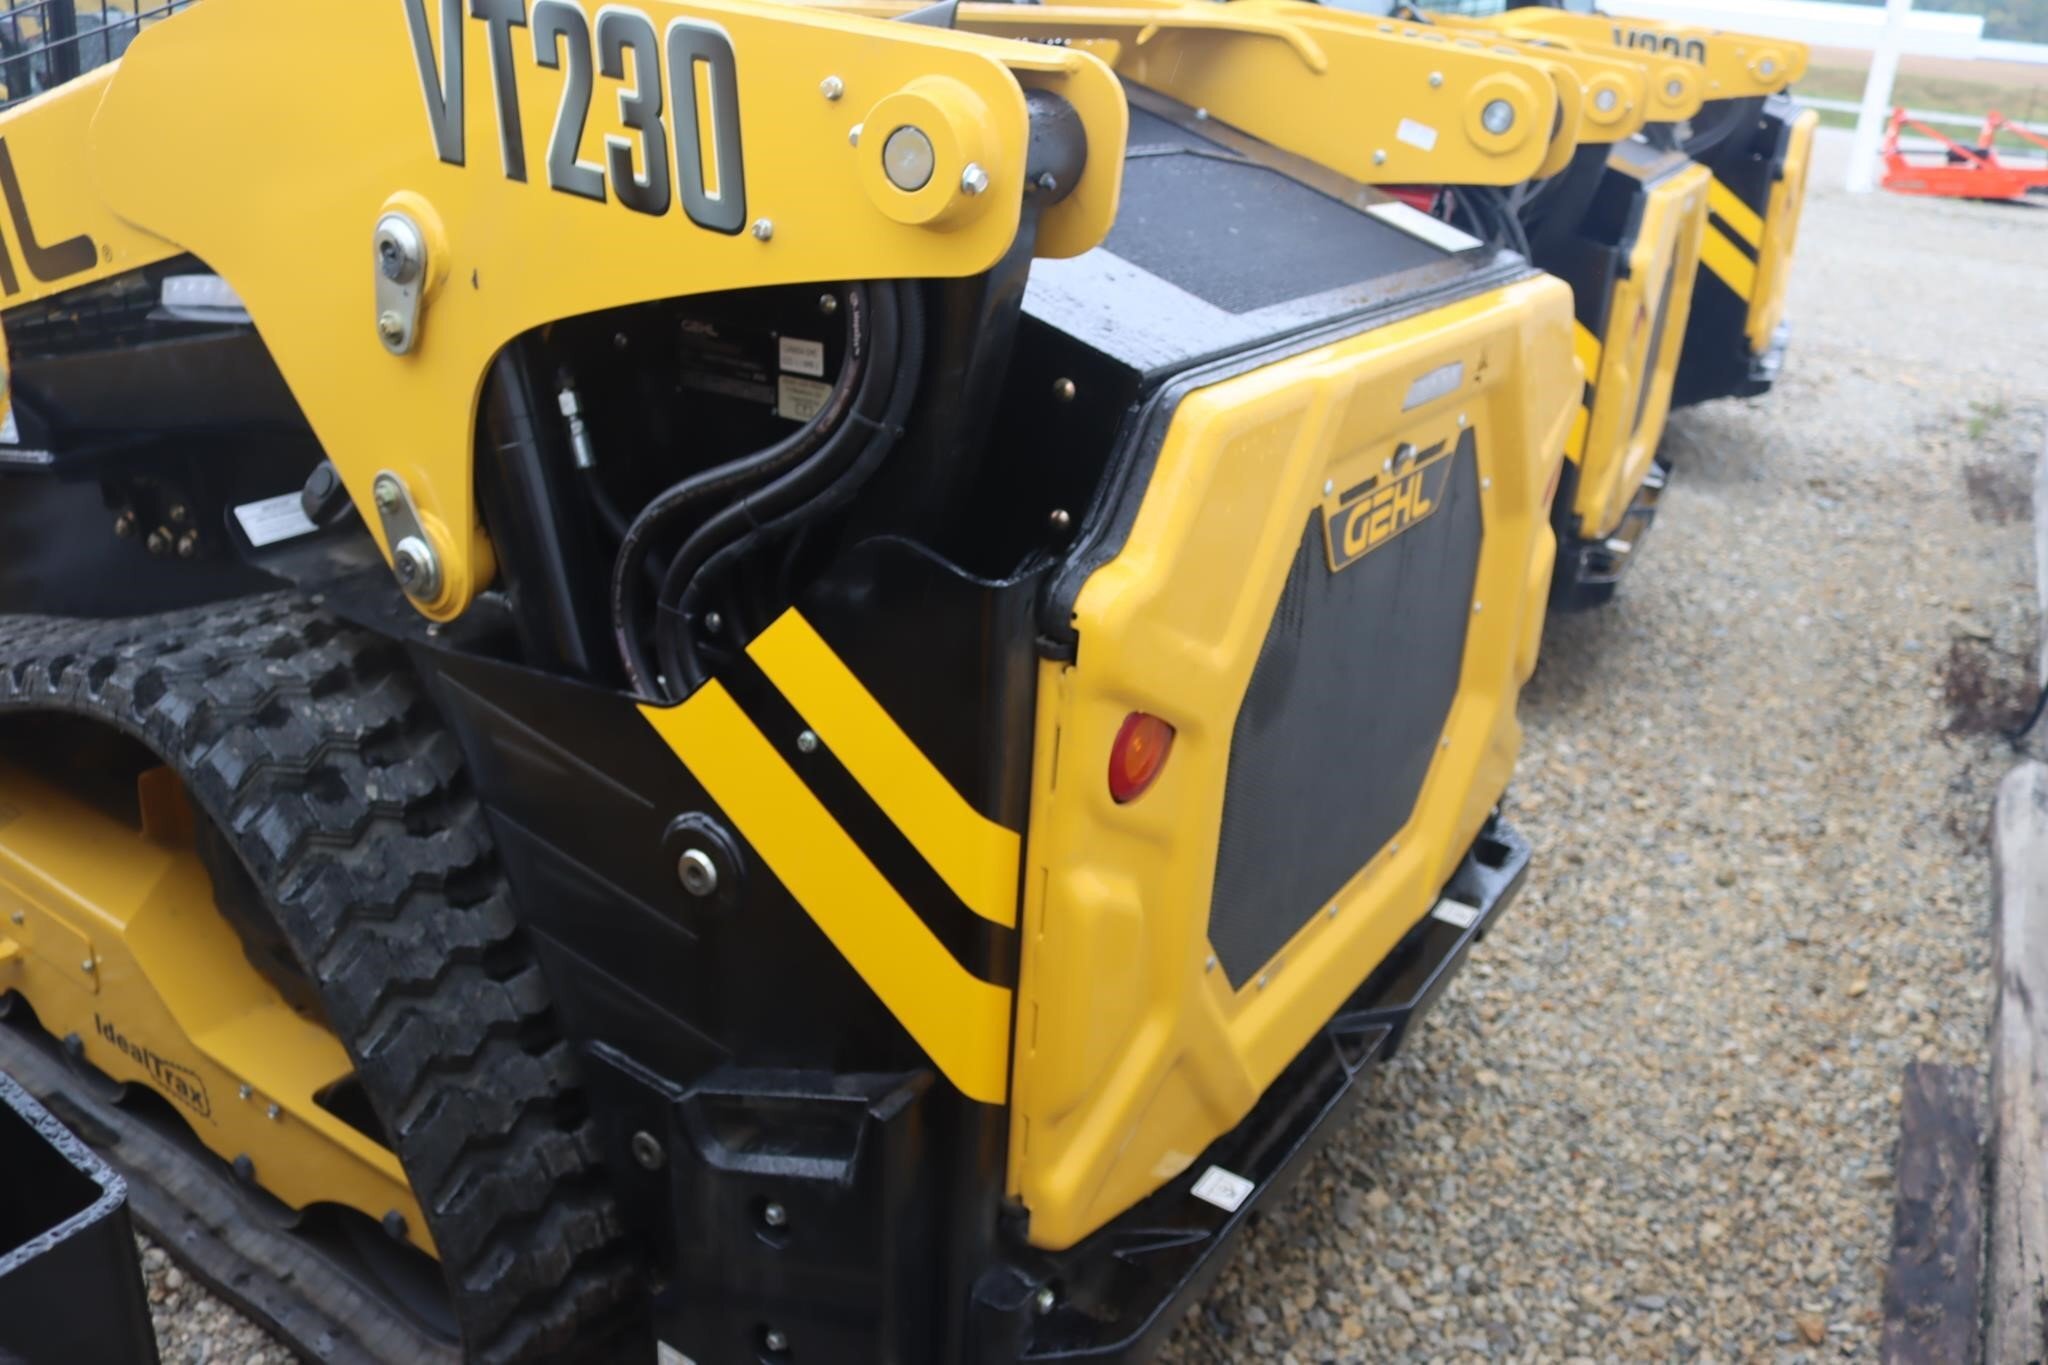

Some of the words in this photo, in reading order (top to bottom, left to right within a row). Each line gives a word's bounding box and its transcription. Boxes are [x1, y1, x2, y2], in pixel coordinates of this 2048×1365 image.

[401, 0, 748, 236] VT230
[1344, 471, 1431, 558] GEHL
[94, 1011, 206, 1112] IdealTrax
